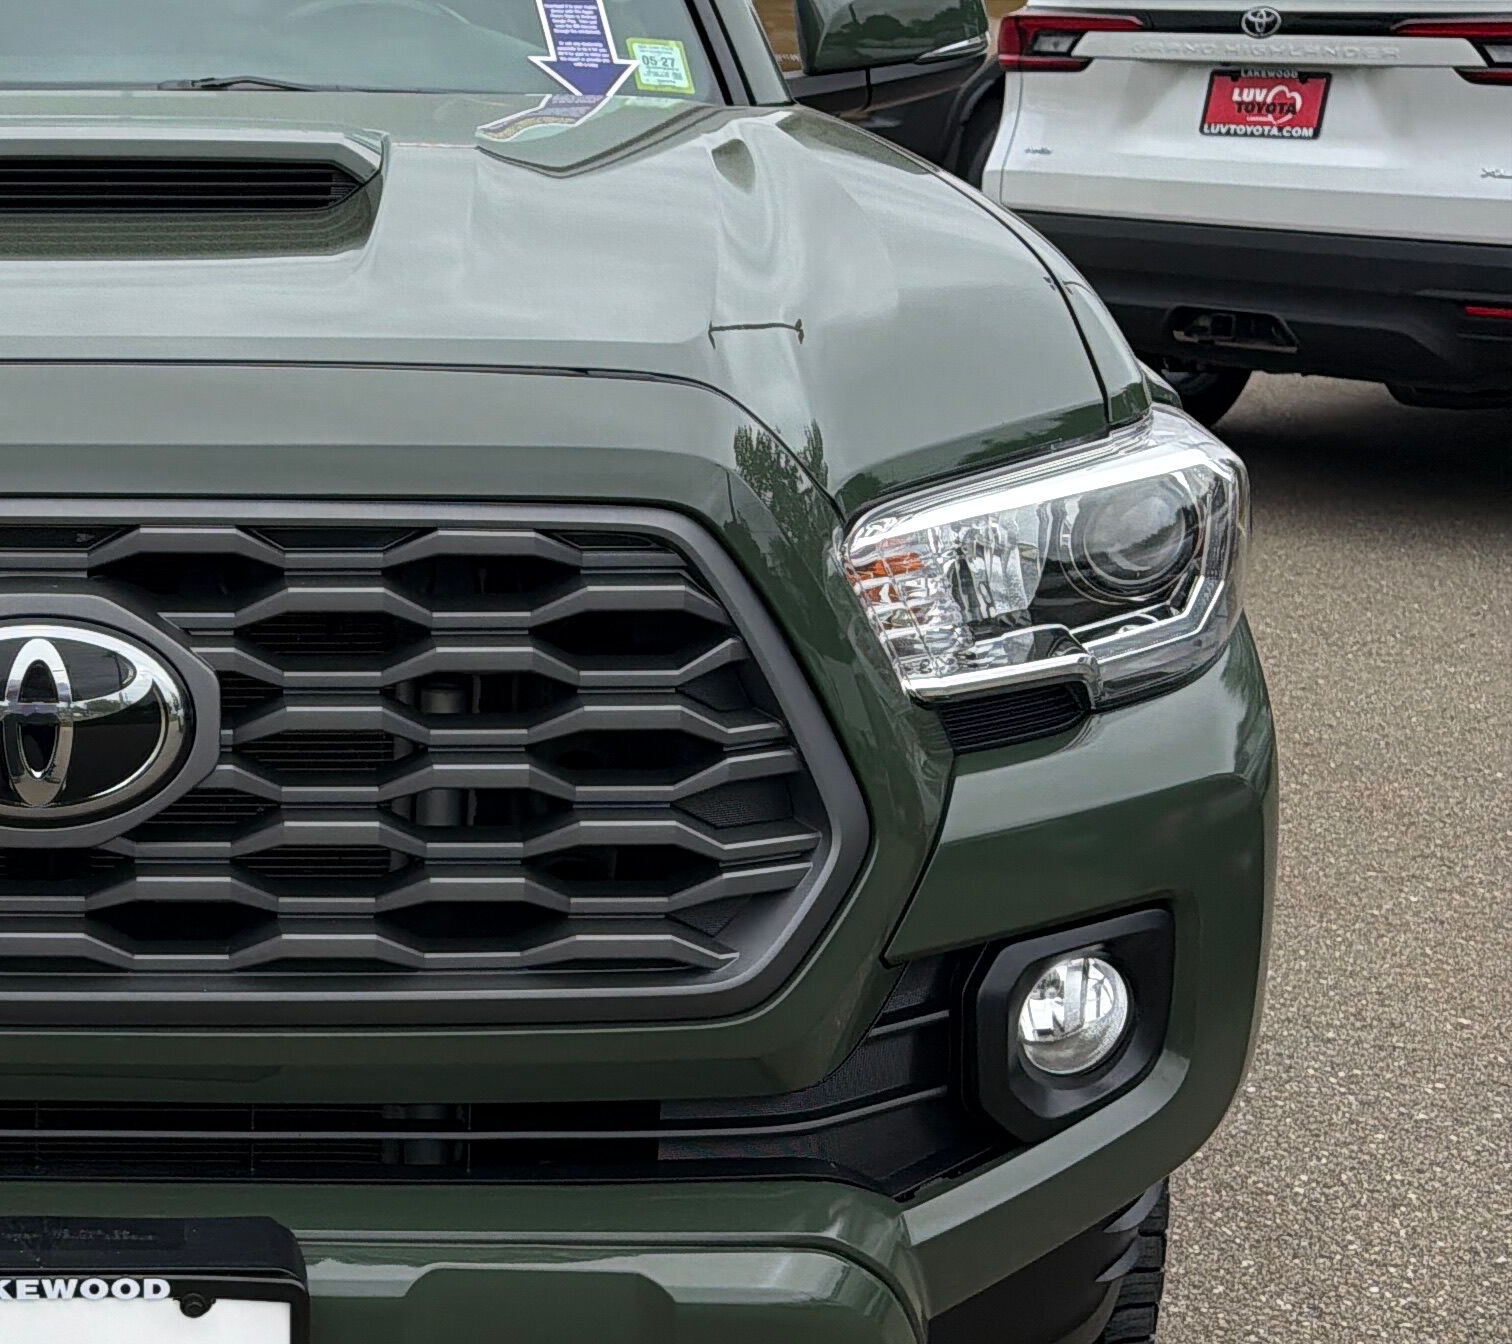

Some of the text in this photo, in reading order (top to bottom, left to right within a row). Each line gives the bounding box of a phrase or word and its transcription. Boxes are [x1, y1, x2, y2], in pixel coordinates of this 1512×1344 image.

[1240, 68, 1299, 79] LAKEWOOD
[1232, 87, 1269, 102] LUV
[1236, 102, 1297, 115] TOYOTA
[1203, 123, 1314, 138] LUVTOYOTA.COM
